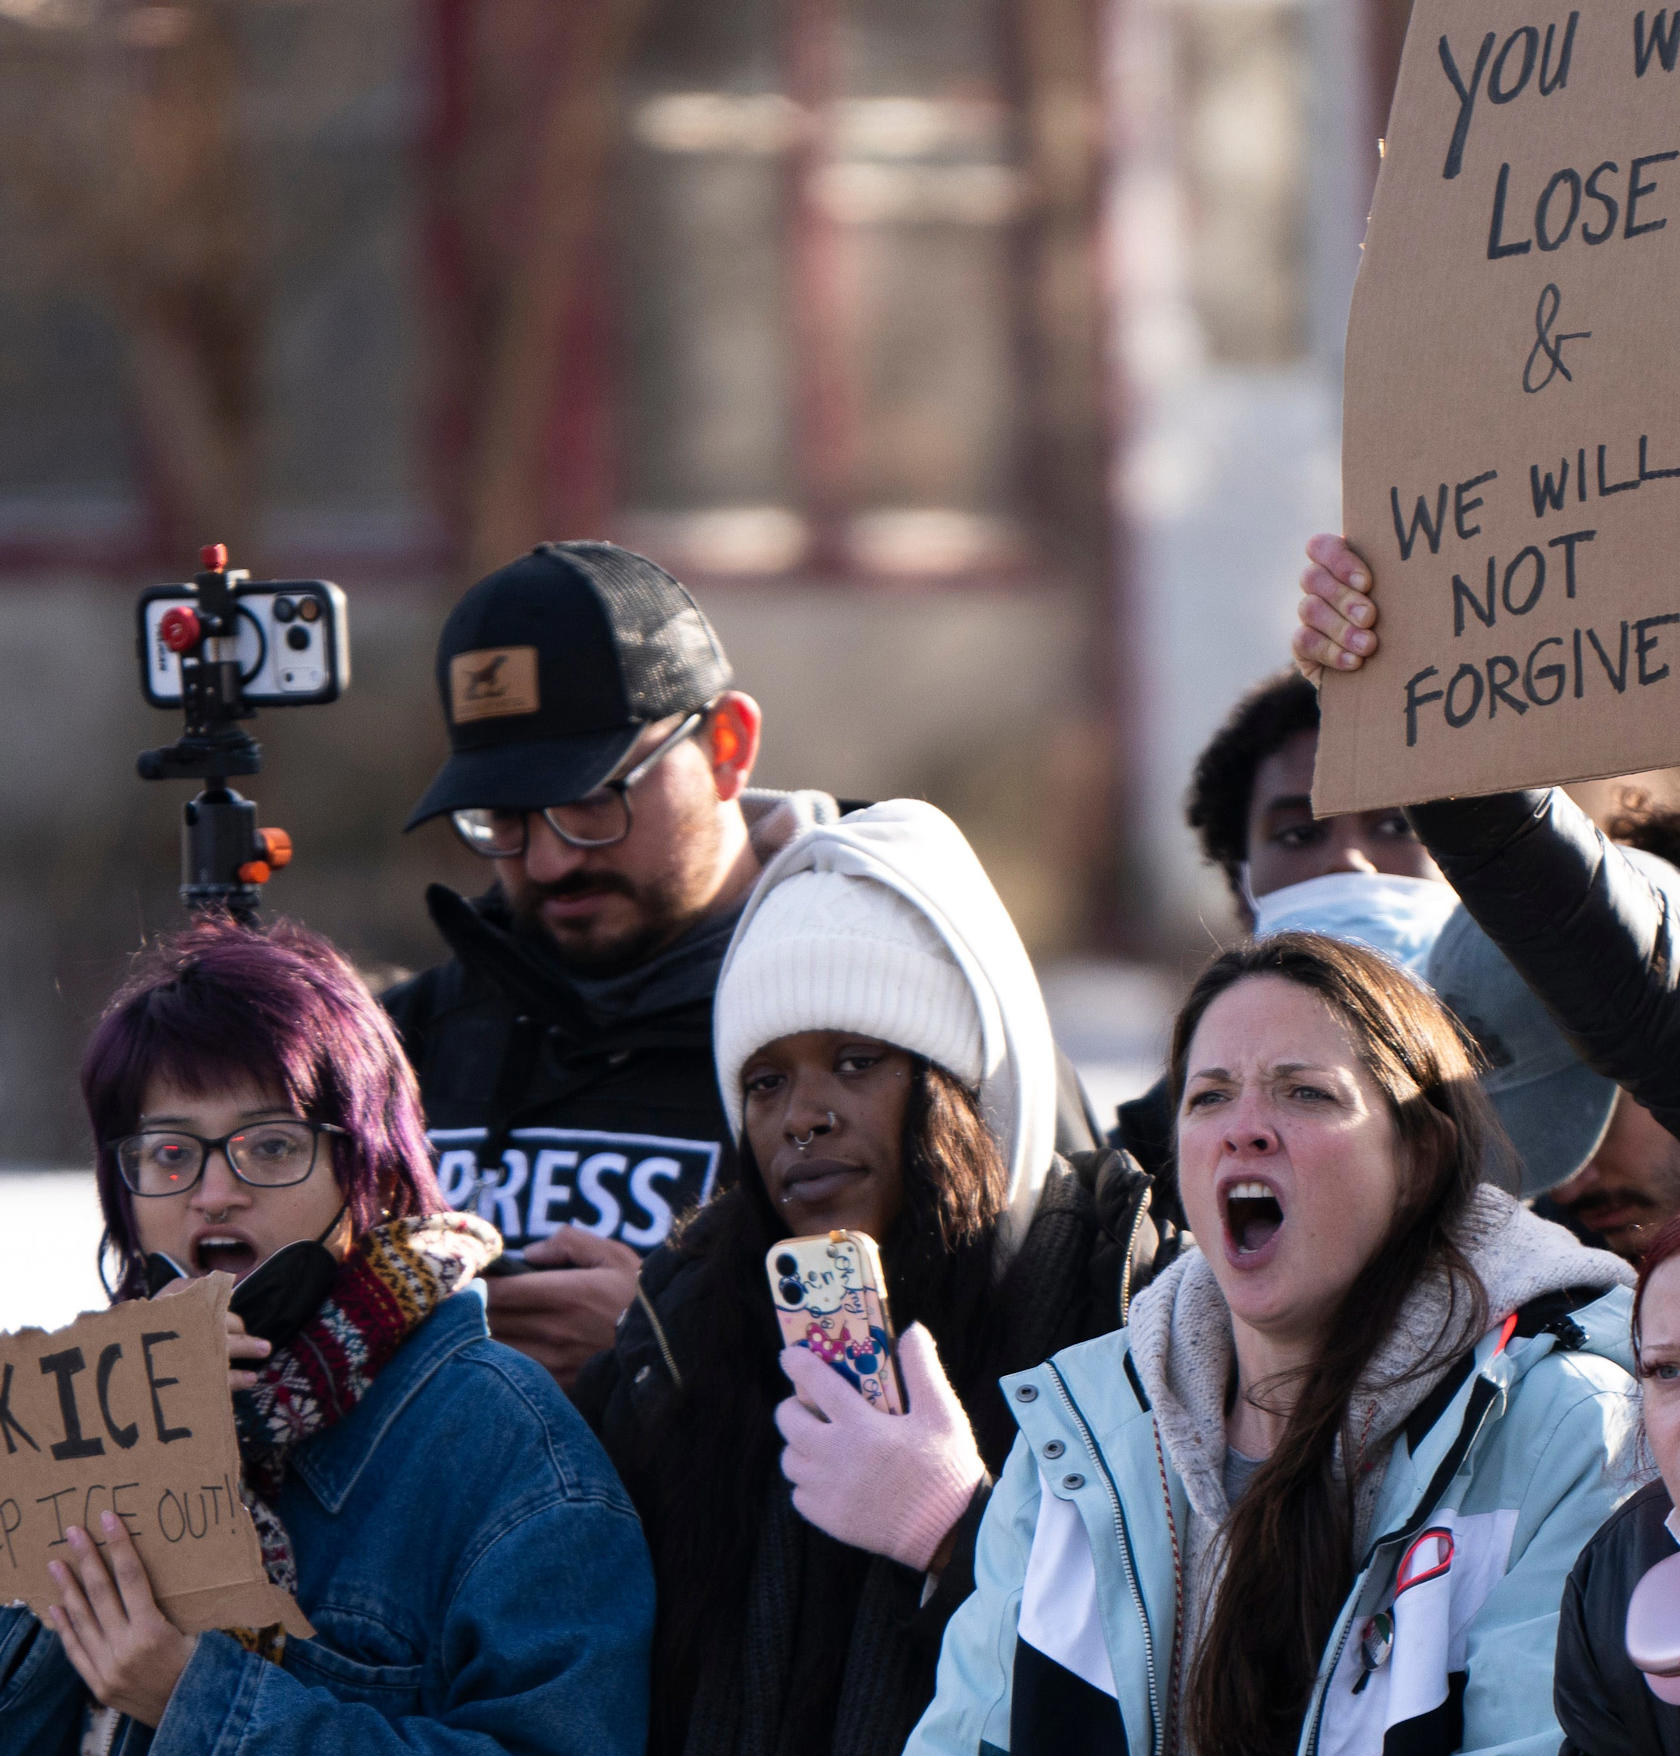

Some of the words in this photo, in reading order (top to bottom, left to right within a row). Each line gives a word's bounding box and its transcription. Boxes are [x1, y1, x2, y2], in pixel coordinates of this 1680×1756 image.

[1438, 9, 1580, 179] YOU
[1486, 150, 1680, 260] LOSE
[1521, 283, 1592, 393] &
[1389, 469, 1498, 561] WE
[1451, 529, 1597, 638] NOT
[436, 1148, 682, 1248] PRESS
[36, 1482, 142, 1547] ICE
[157, 1474, 237, 1543] OUT!
